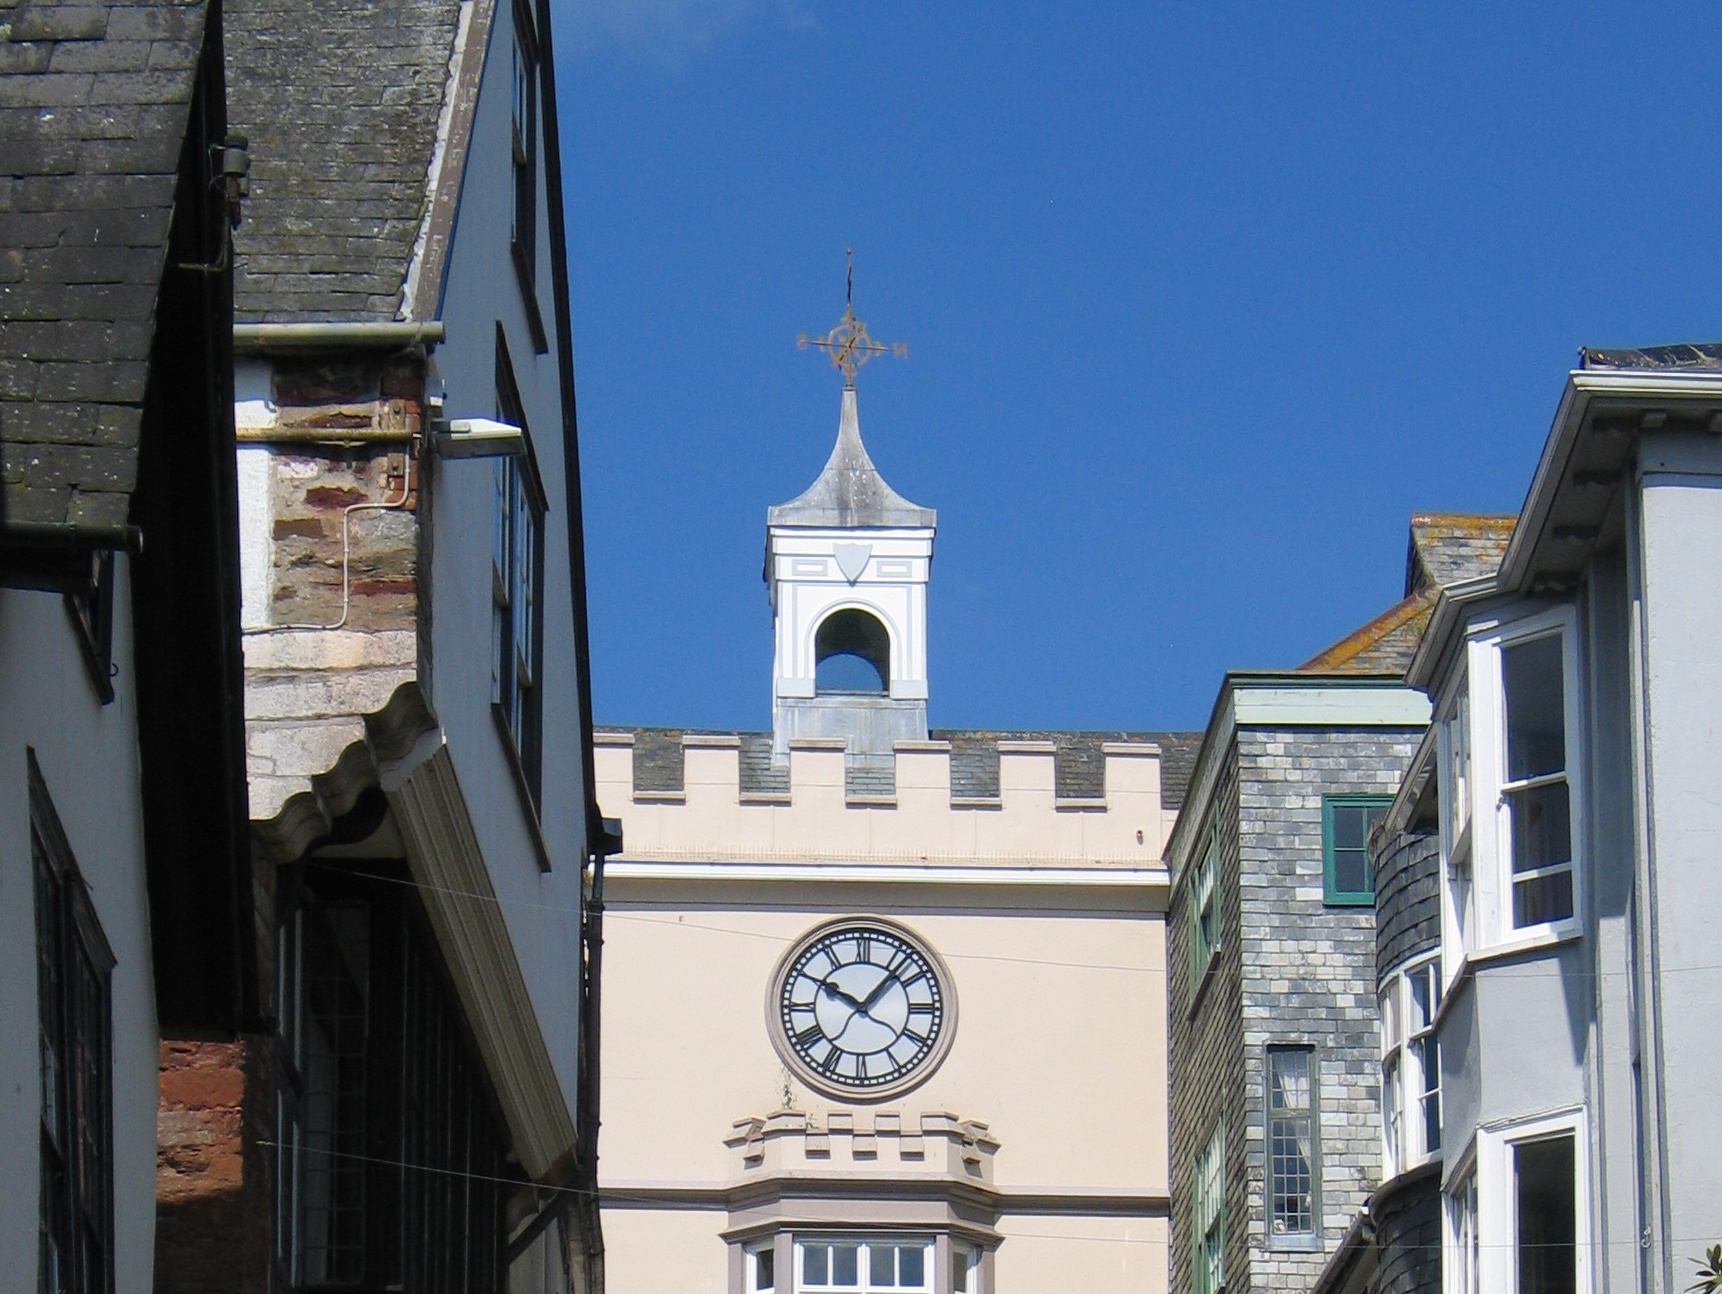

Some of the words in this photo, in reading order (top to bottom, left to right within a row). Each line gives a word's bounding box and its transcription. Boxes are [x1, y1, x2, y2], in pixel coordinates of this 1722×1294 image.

[856, 938, 871, 963] XII
[902, 970, 927, 988] II
[909, 1002, 934, 1015] III
[797, 1024, 825, 1050] VIII
[822, 1046, 843, 1074] VII
[855, 1054, 868, 1078] VI
